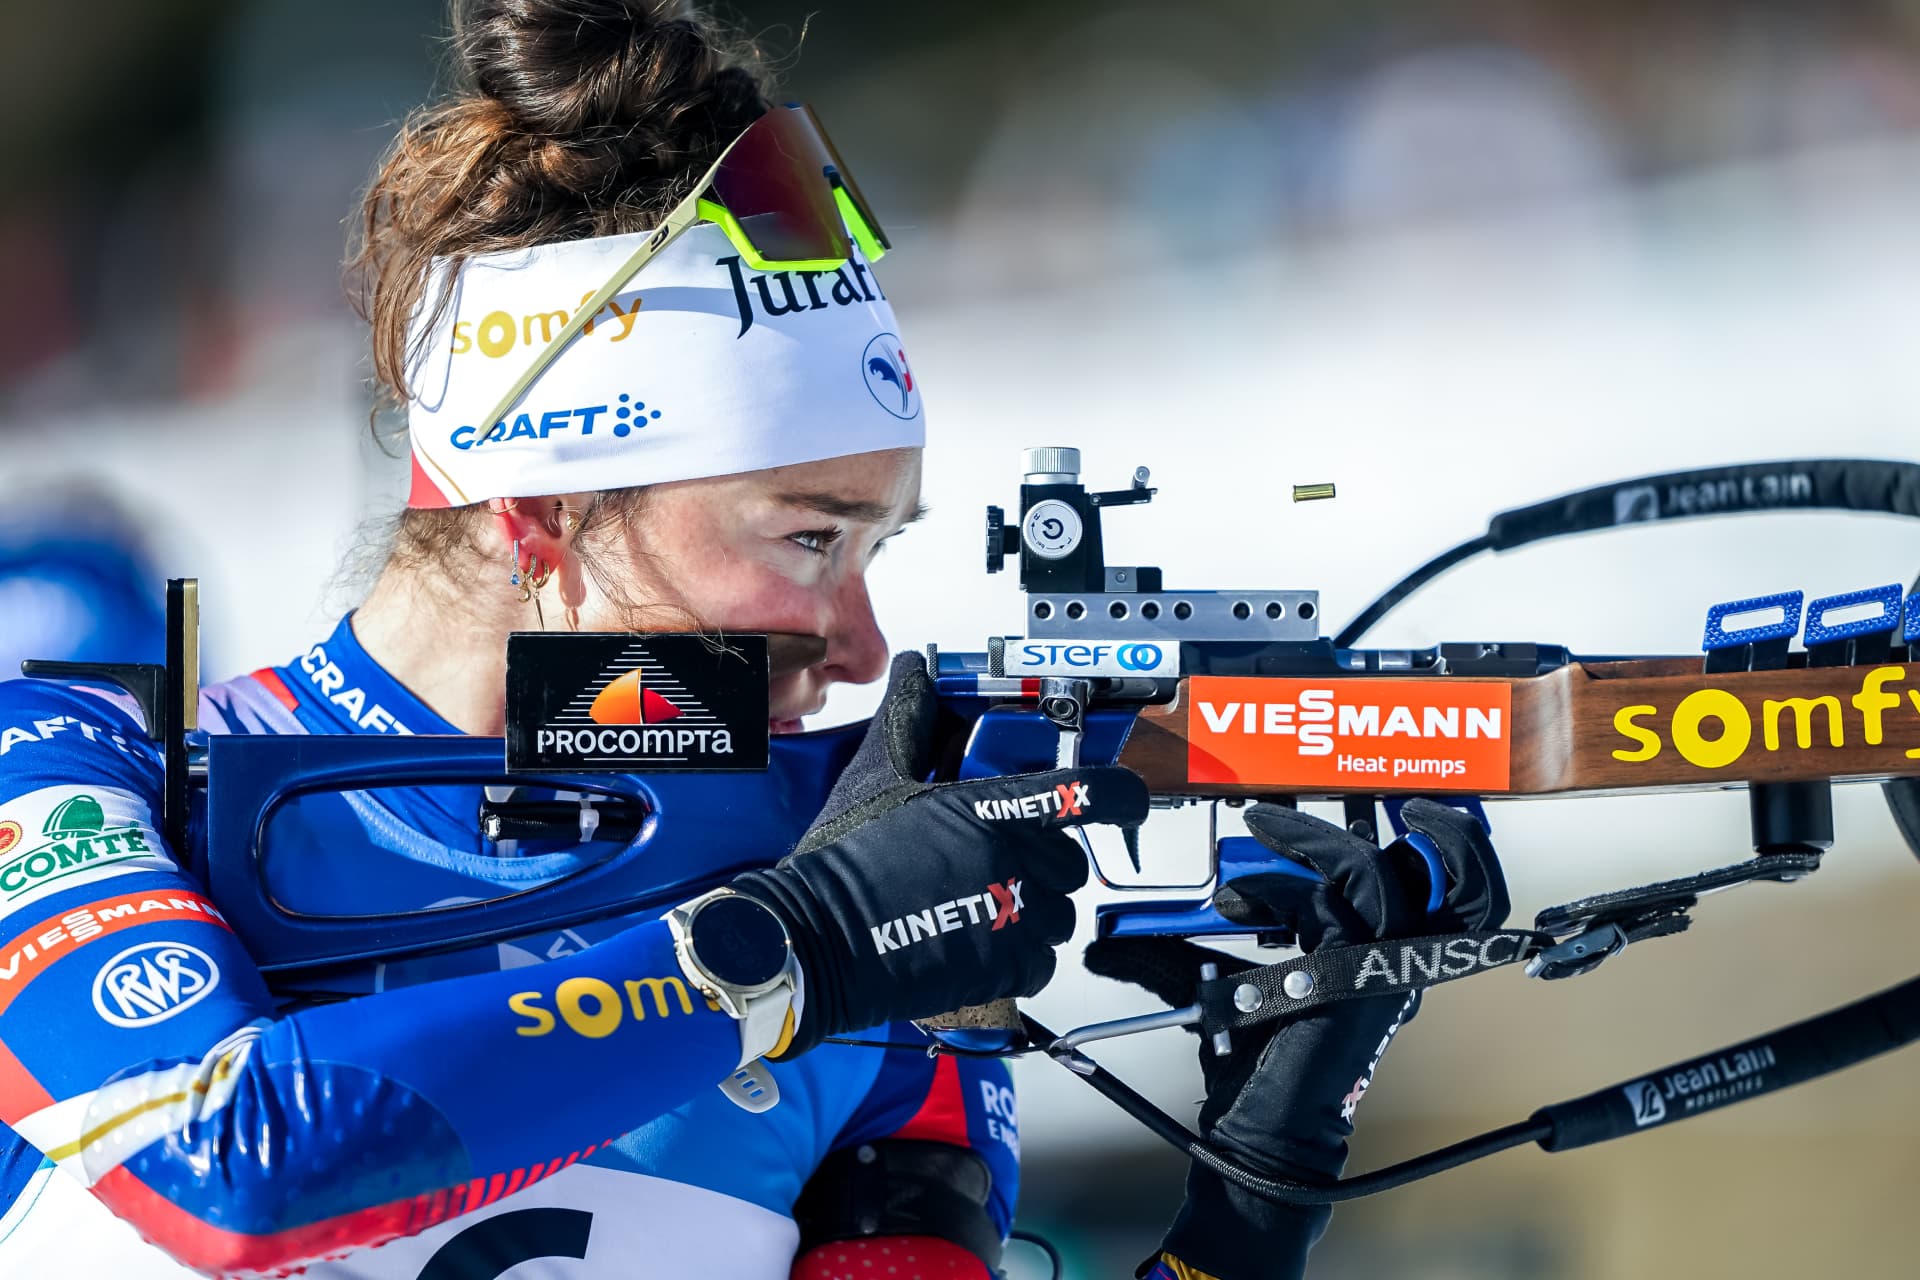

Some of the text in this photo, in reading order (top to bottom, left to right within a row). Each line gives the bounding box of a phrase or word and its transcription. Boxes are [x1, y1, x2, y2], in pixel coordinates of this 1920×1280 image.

[1197, 689, 1502, 756] VIESSMANN
[1611, 666, 1920, 769] somf
[1337, 754, 1467, 778] Heat pumps
[974, 780, 1091, 820] KINETIXX
[0, 898, 228, 981] VIESSMANN
[870, 876, 1025, 955] KINETIXX
[105, 948, 205, 1019] RWS
[508, 976, 721, 1039] som
[1664, 1062, 1720, 1099] Jean
